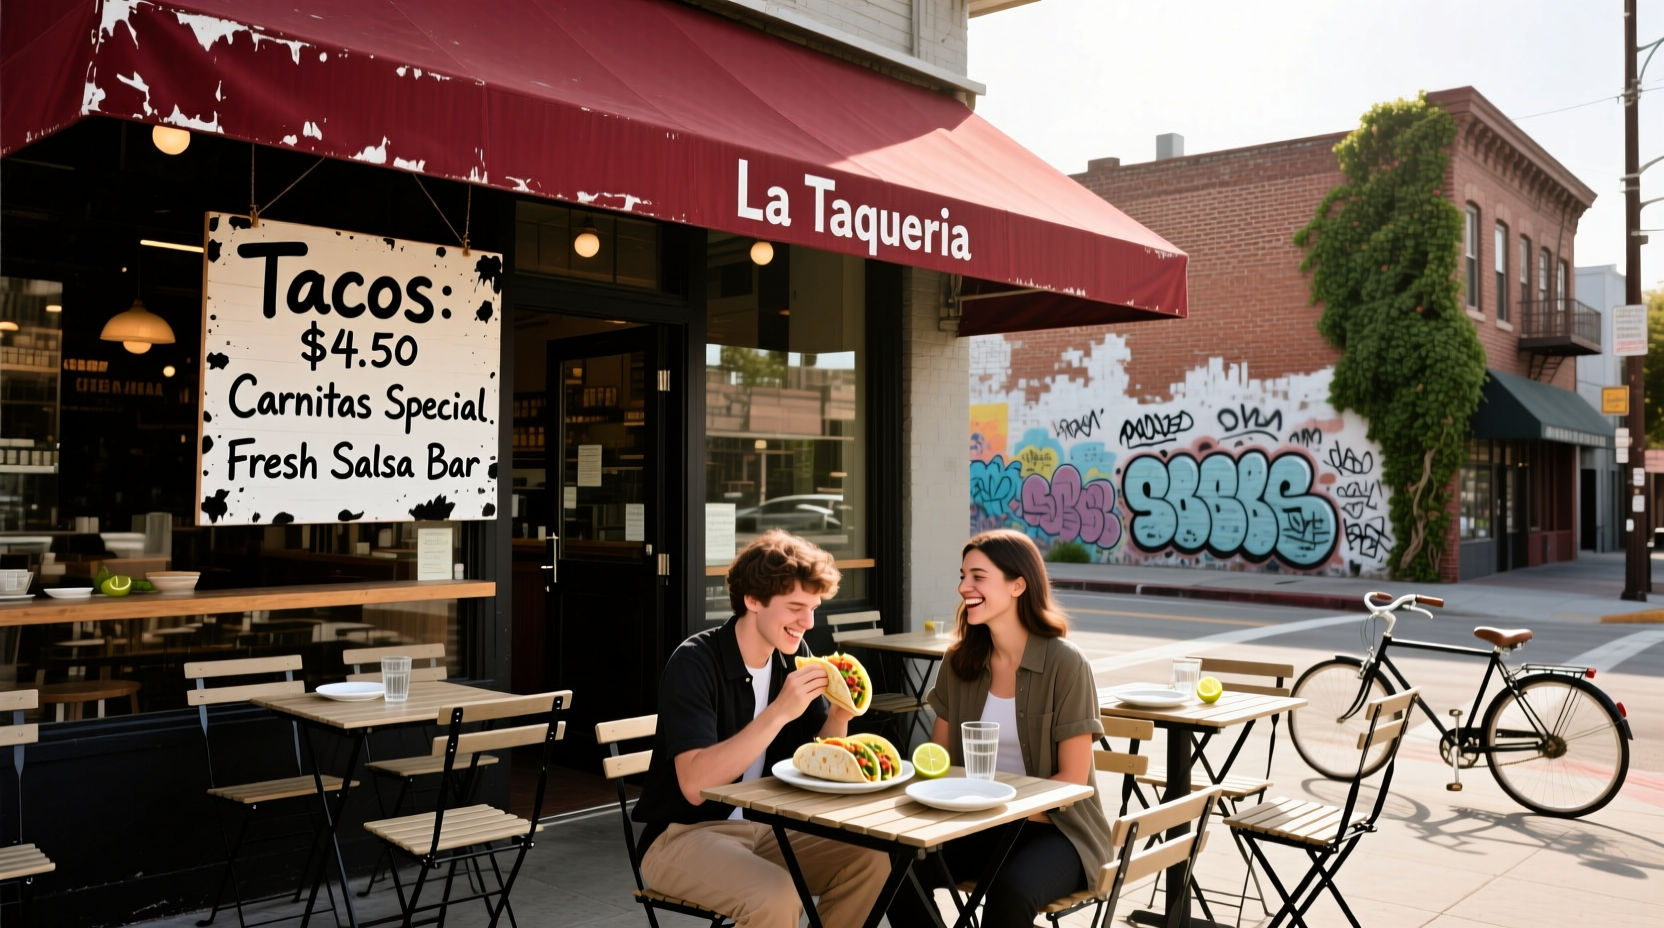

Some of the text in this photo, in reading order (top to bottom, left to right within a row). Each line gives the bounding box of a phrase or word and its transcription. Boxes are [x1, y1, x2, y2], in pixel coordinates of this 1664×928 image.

[737, 158, 972, 261] La Taqueria
[236, 241, 453, 324] Tacos:
[300, 320, 418, 372] $4.50
[228, 372, 372, 420] Carnitas
[227, 437, 481, 482] Fresh Salsa Bar
